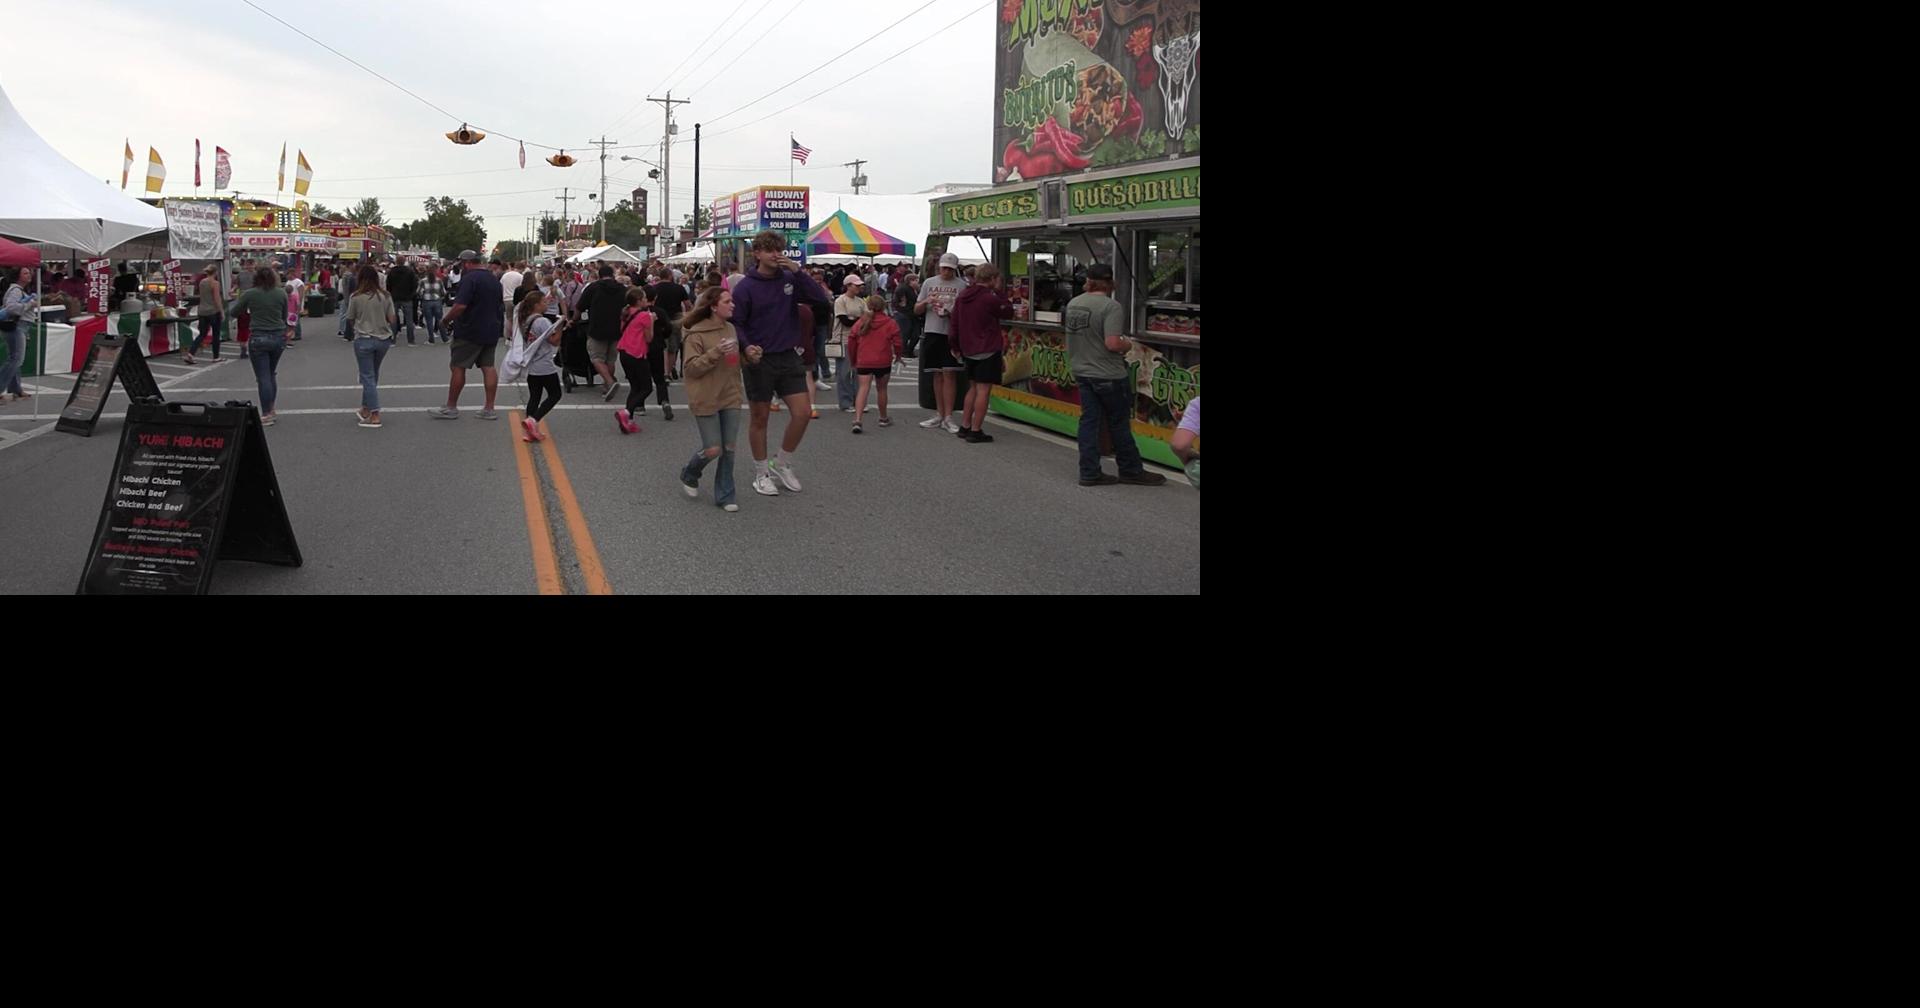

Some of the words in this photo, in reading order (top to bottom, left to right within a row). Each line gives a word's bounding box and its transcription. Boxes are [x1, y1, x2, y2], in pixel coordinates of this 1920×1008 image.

[1004, 60, 1078, 129] BURRITOS
[765, 190, 806, 199] MIDWAY
[1073, 176, 1200, 213] QUESADILL
[766, 200, 805, 209] CREDITS
[763, 211, 769, 219] &
[770, 211, 806, 219] WRISTBANDS
[770, 221, 784, 229] SOLD
[785, 221, 800, 229] HERE
[248, 237, 284, 246] CANDY
[790, 239, 798, 247] &
[782, 249, 802, 257] OAD
[89, 270, 99, 298] STEAK
[173, 436, 224, 448] HIBACHI
[122, 475, 150, 484] Hibachi
[151, 477, 181, 486] Chicken
[119, 487, 146, 496] Hibachi
[116, 500, 145, 508] Chicken
